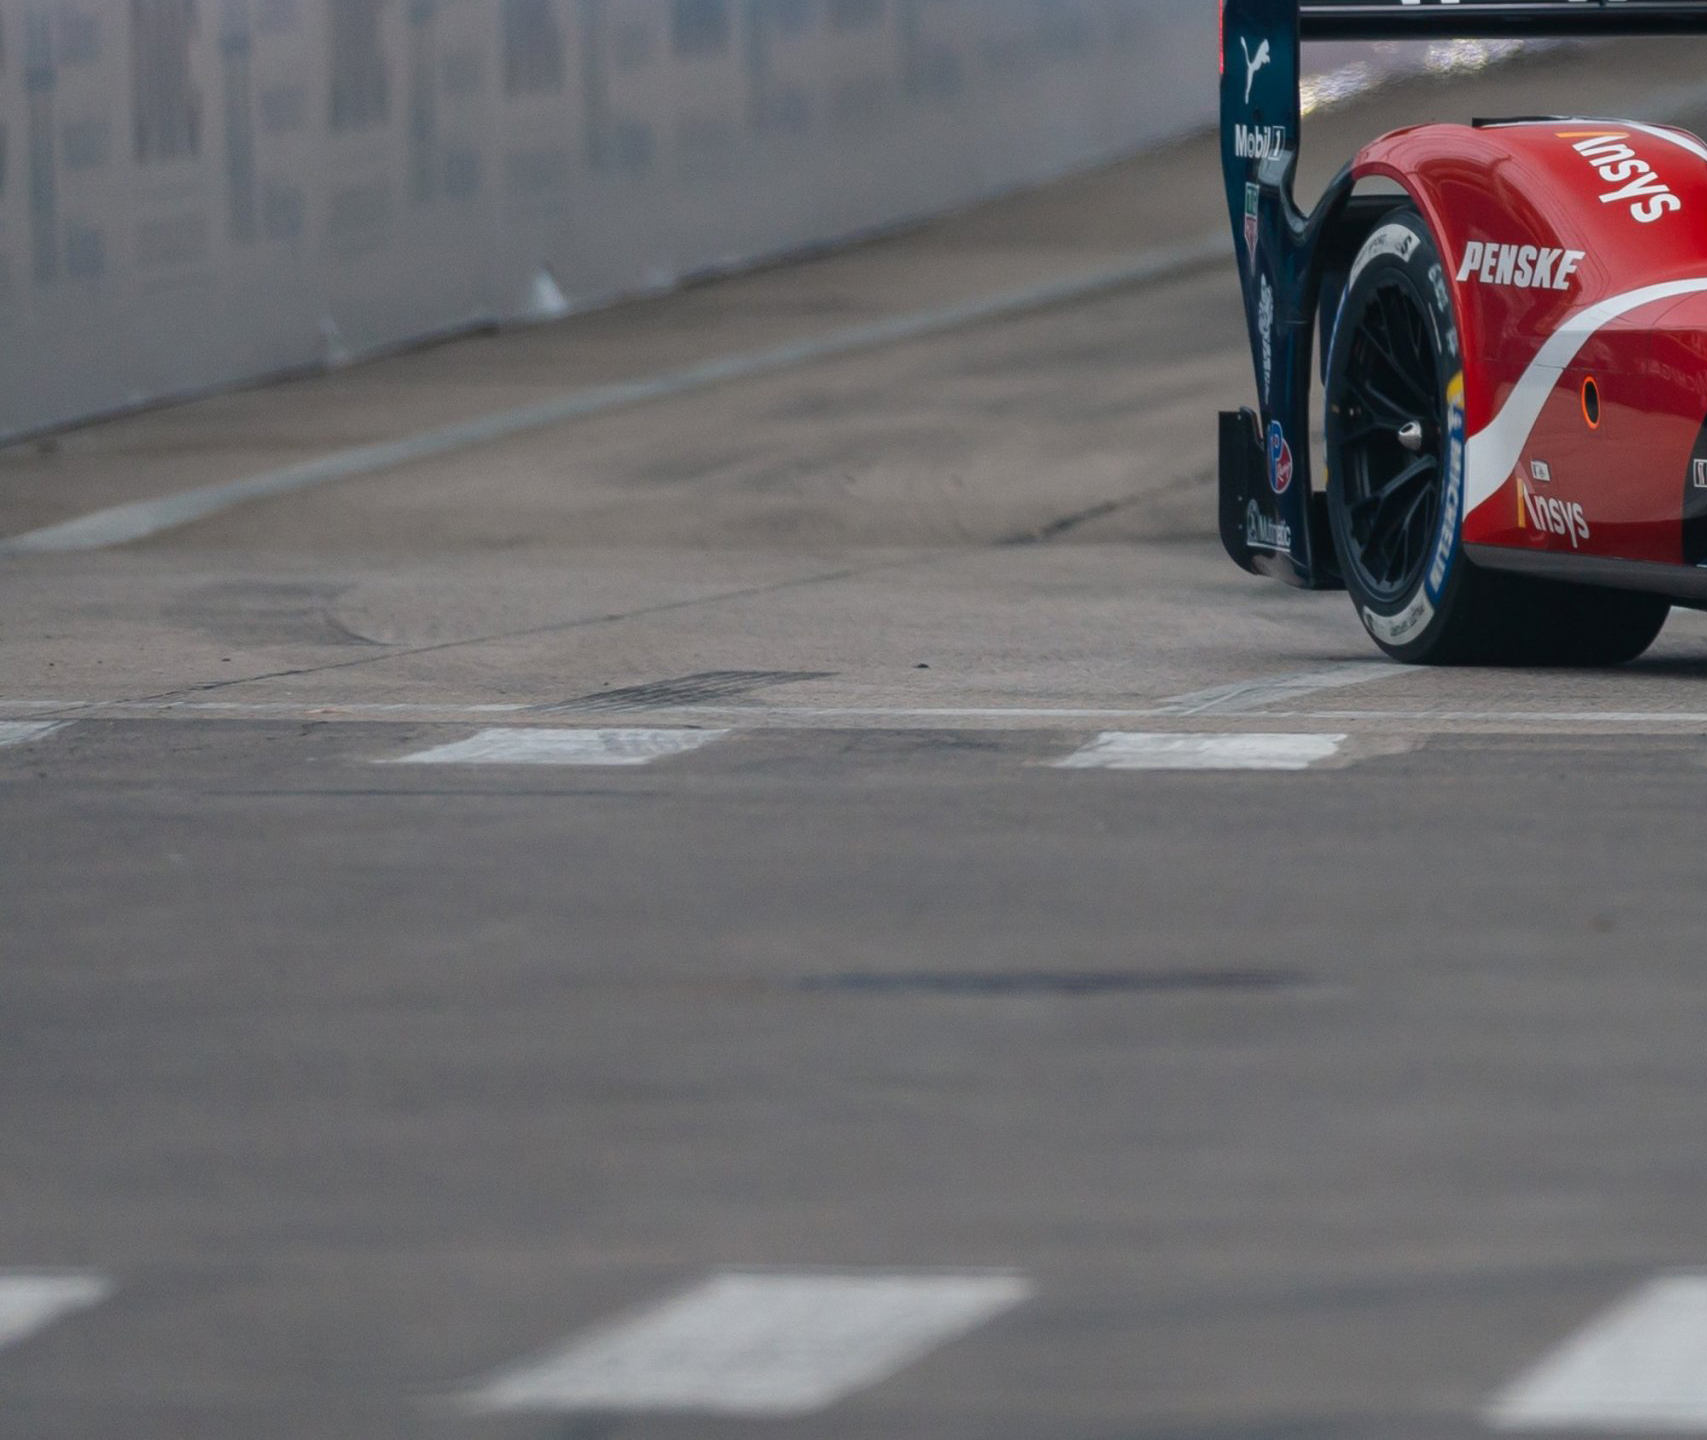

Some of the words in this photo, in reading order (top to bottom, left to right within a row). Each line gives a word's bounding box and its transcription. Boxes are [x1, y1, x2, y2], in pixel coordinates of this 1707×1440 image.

[1235, 124, 1270, 158] Mobil
[1555, 131, 1681, 223] Ansys
[1456, 241, 1585, 290] PENSKE
[1517, 477, 1590, 549] Ansys
